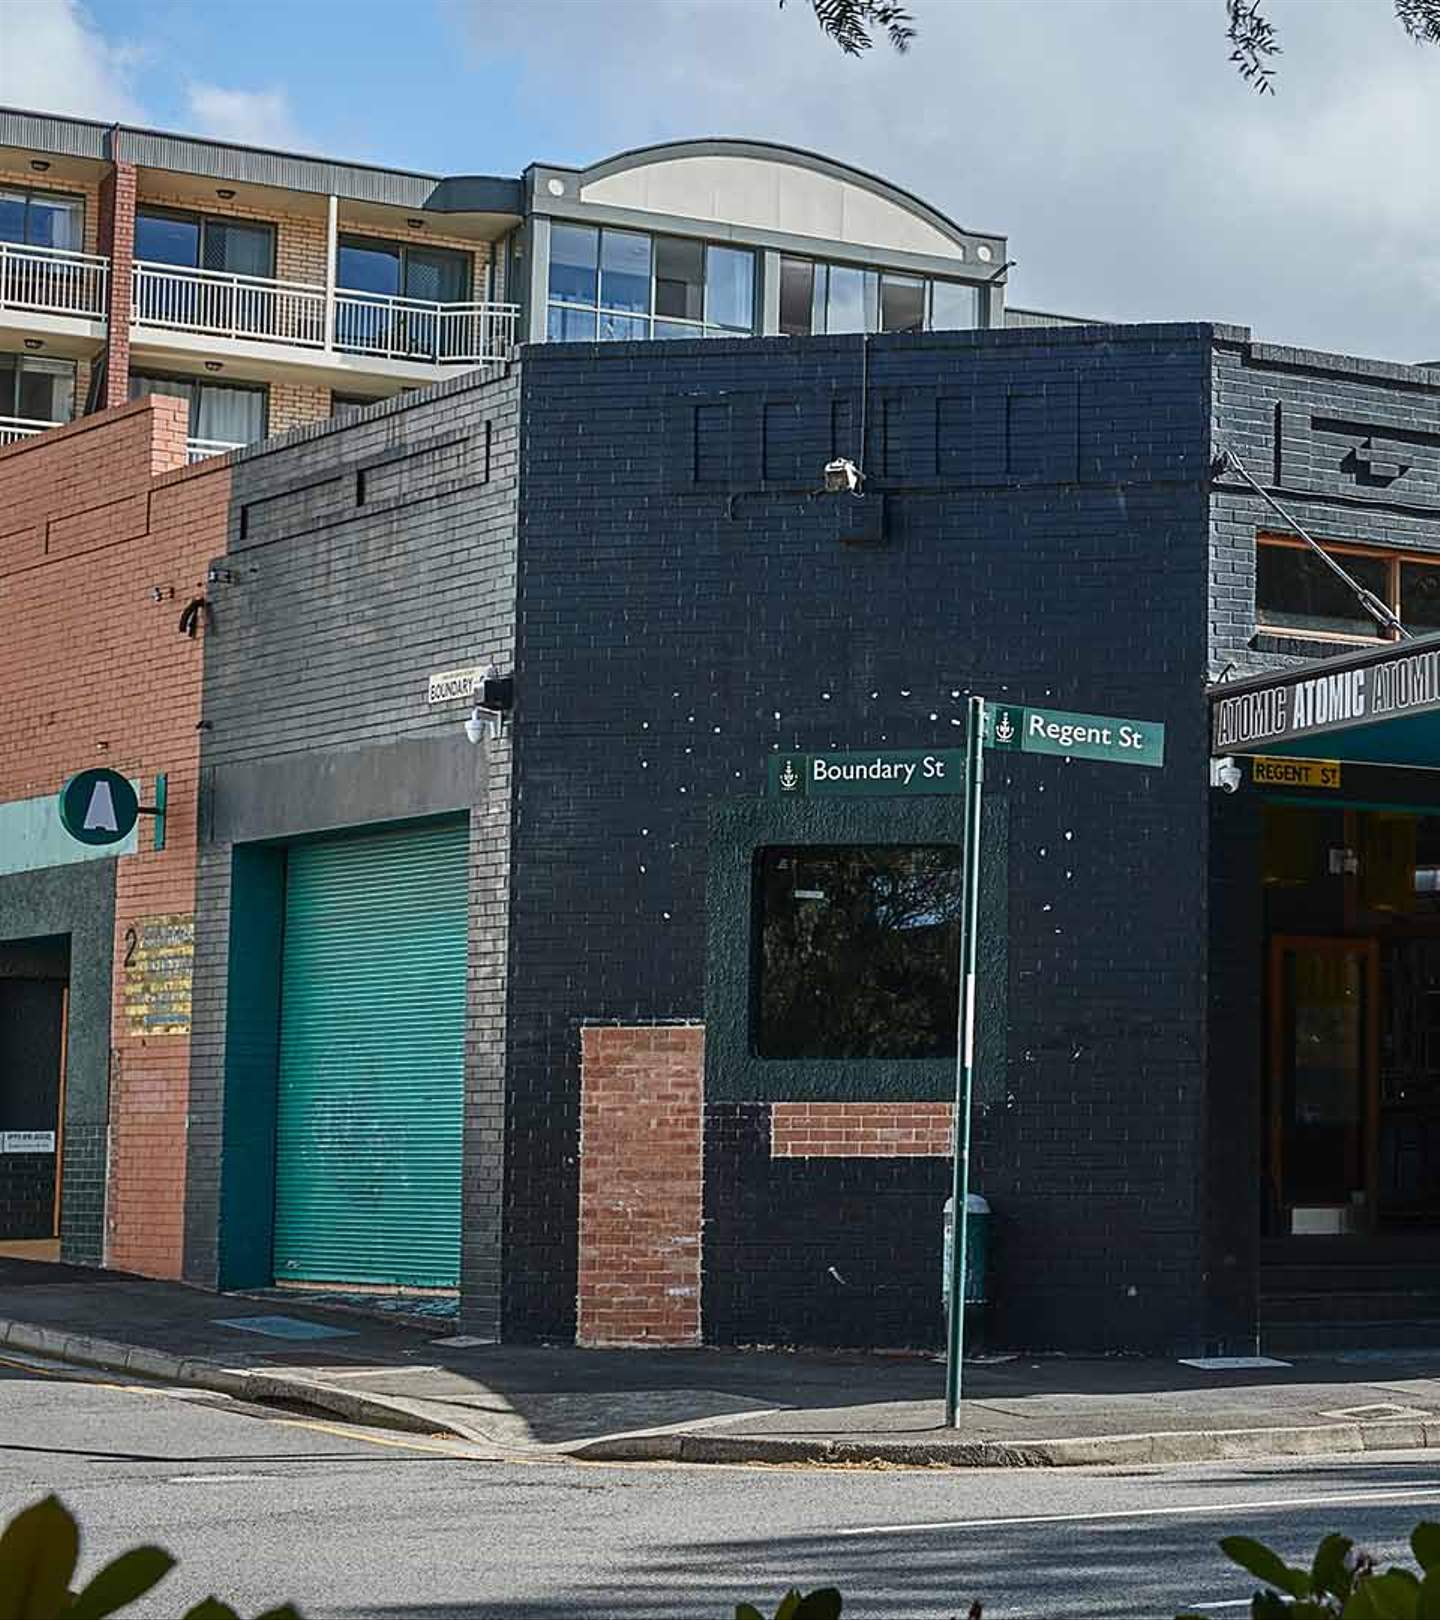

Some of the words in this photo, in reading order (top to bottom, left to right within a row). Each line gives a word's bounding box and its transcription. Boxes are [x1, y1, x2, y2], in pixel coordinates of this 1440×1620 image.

[430, 676, 474, 701] BOUNDARY
[1217, 686, 1287, 747] ATOMIC
[1293, 669, 1365, 730] ATOMIC
[1029, 716, 1112, 746] Regent
[1118, 725, 1143, 750] St
[813, 758, 916, 785] Boundary
[922, 756, 945, 778] St
[1256, 763, 1311, 784] REGENT
[124, 928, 137, 967] 2
